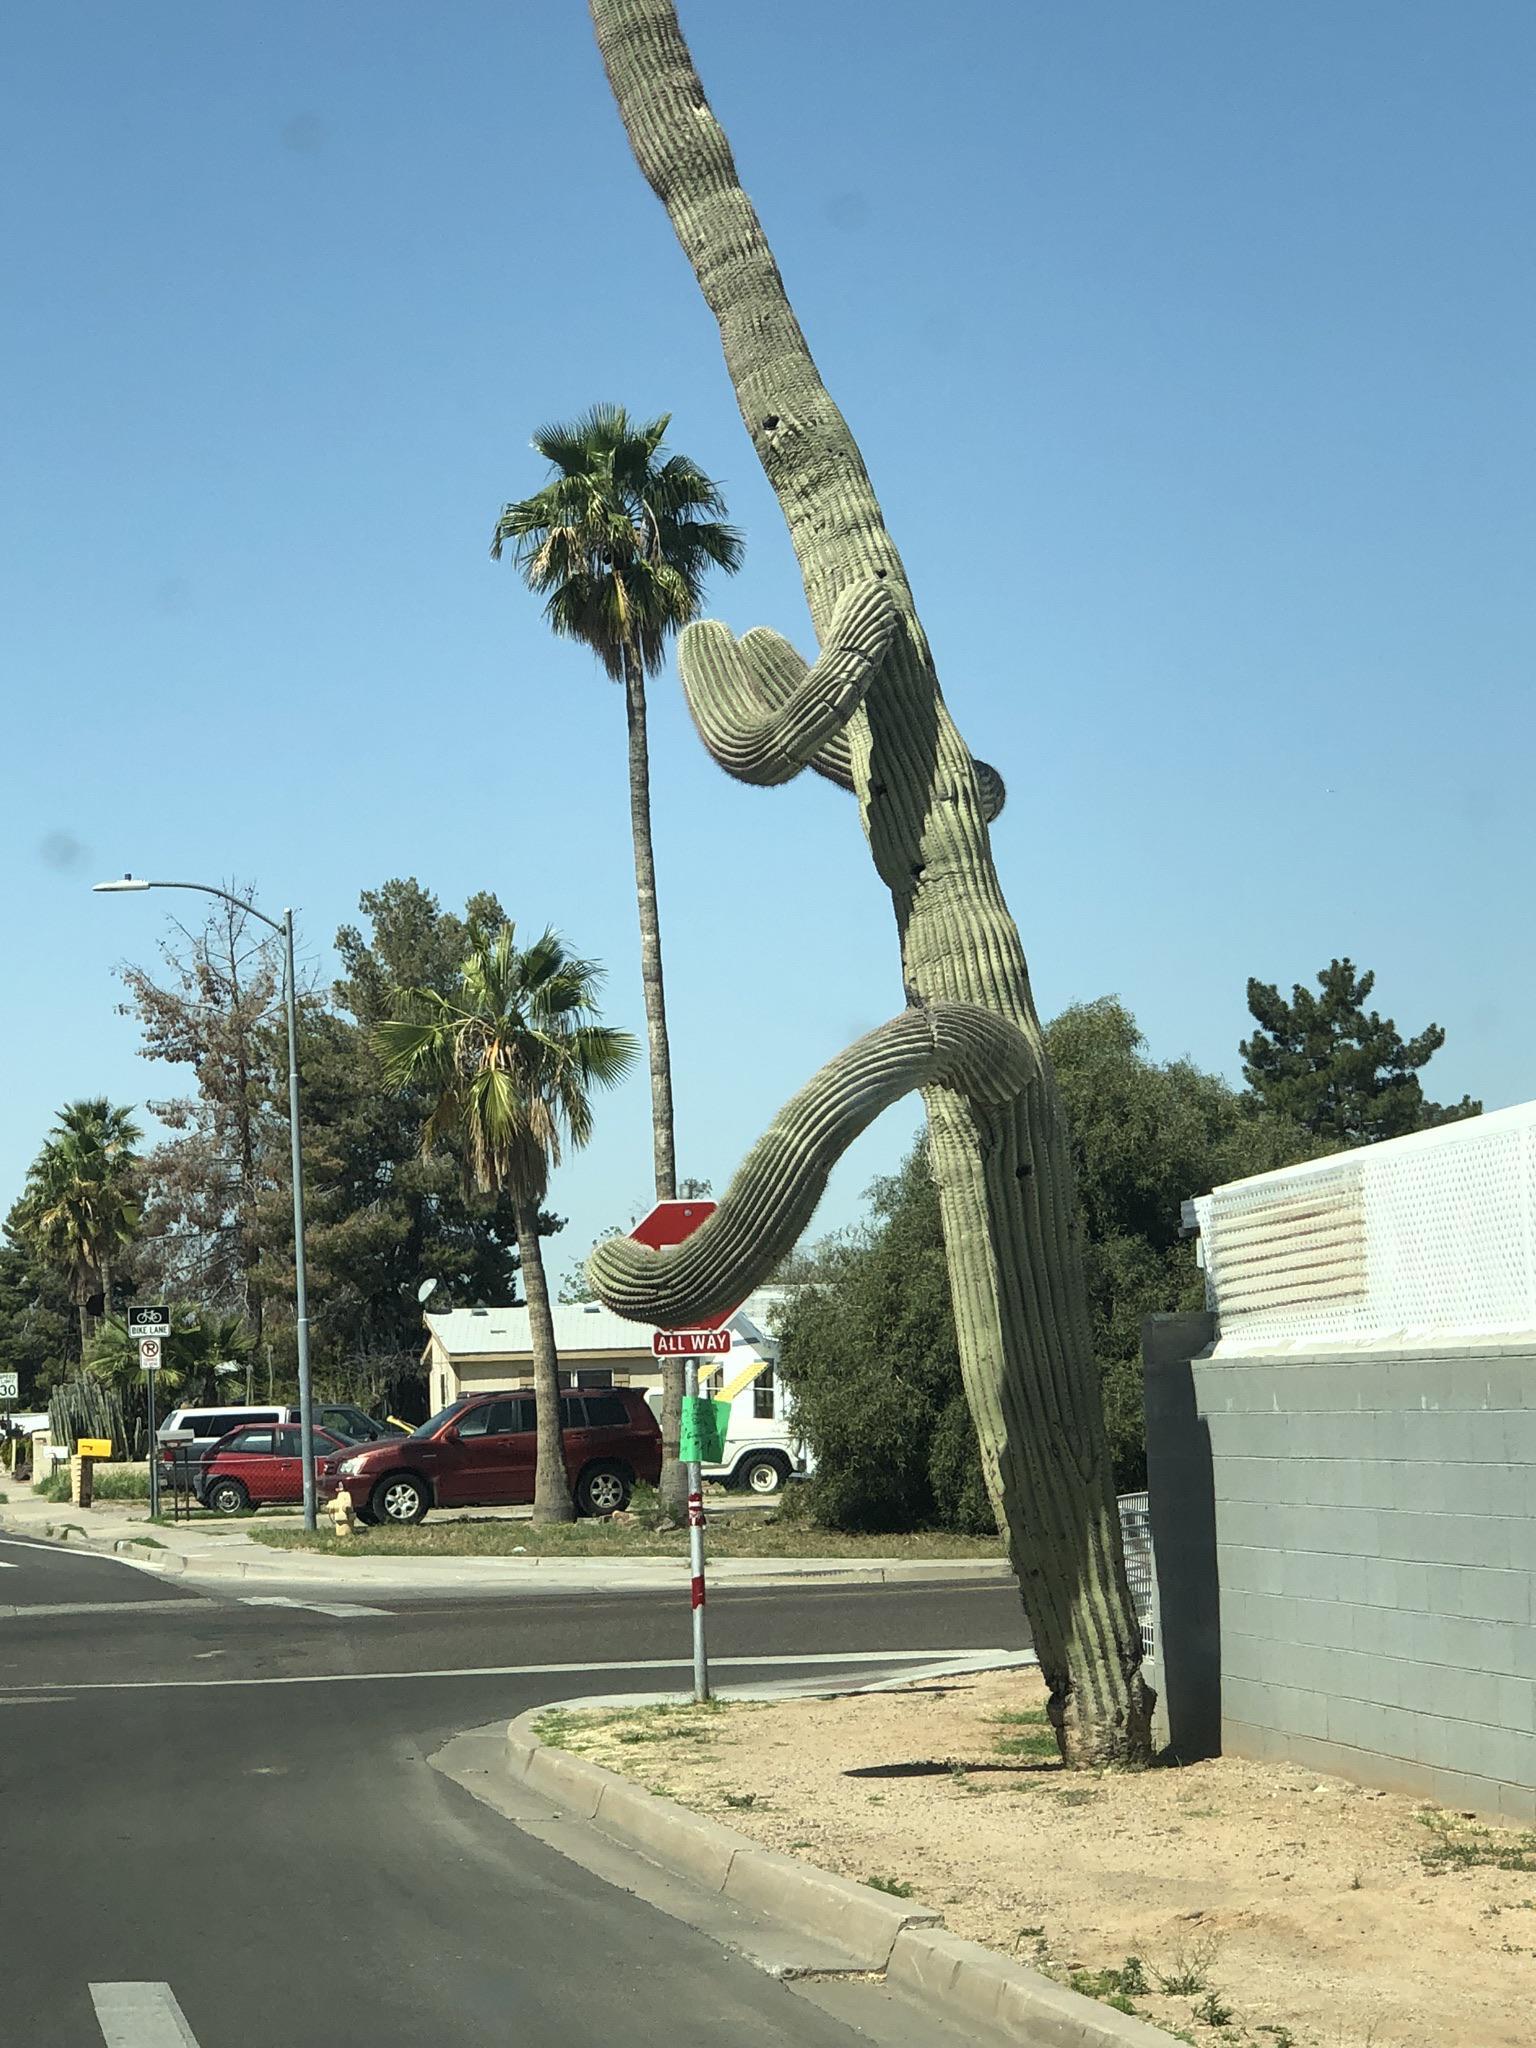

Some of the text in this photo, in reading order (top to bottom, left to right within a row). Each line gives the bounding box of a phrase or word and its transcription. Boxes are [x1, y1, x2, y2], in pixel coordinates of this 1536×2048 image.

[131, 1325, 168, 1335] BIKE LANE
[658, 1334, 727, 1351] ALL WAY
[0, 1385, 16, 1396] 30
